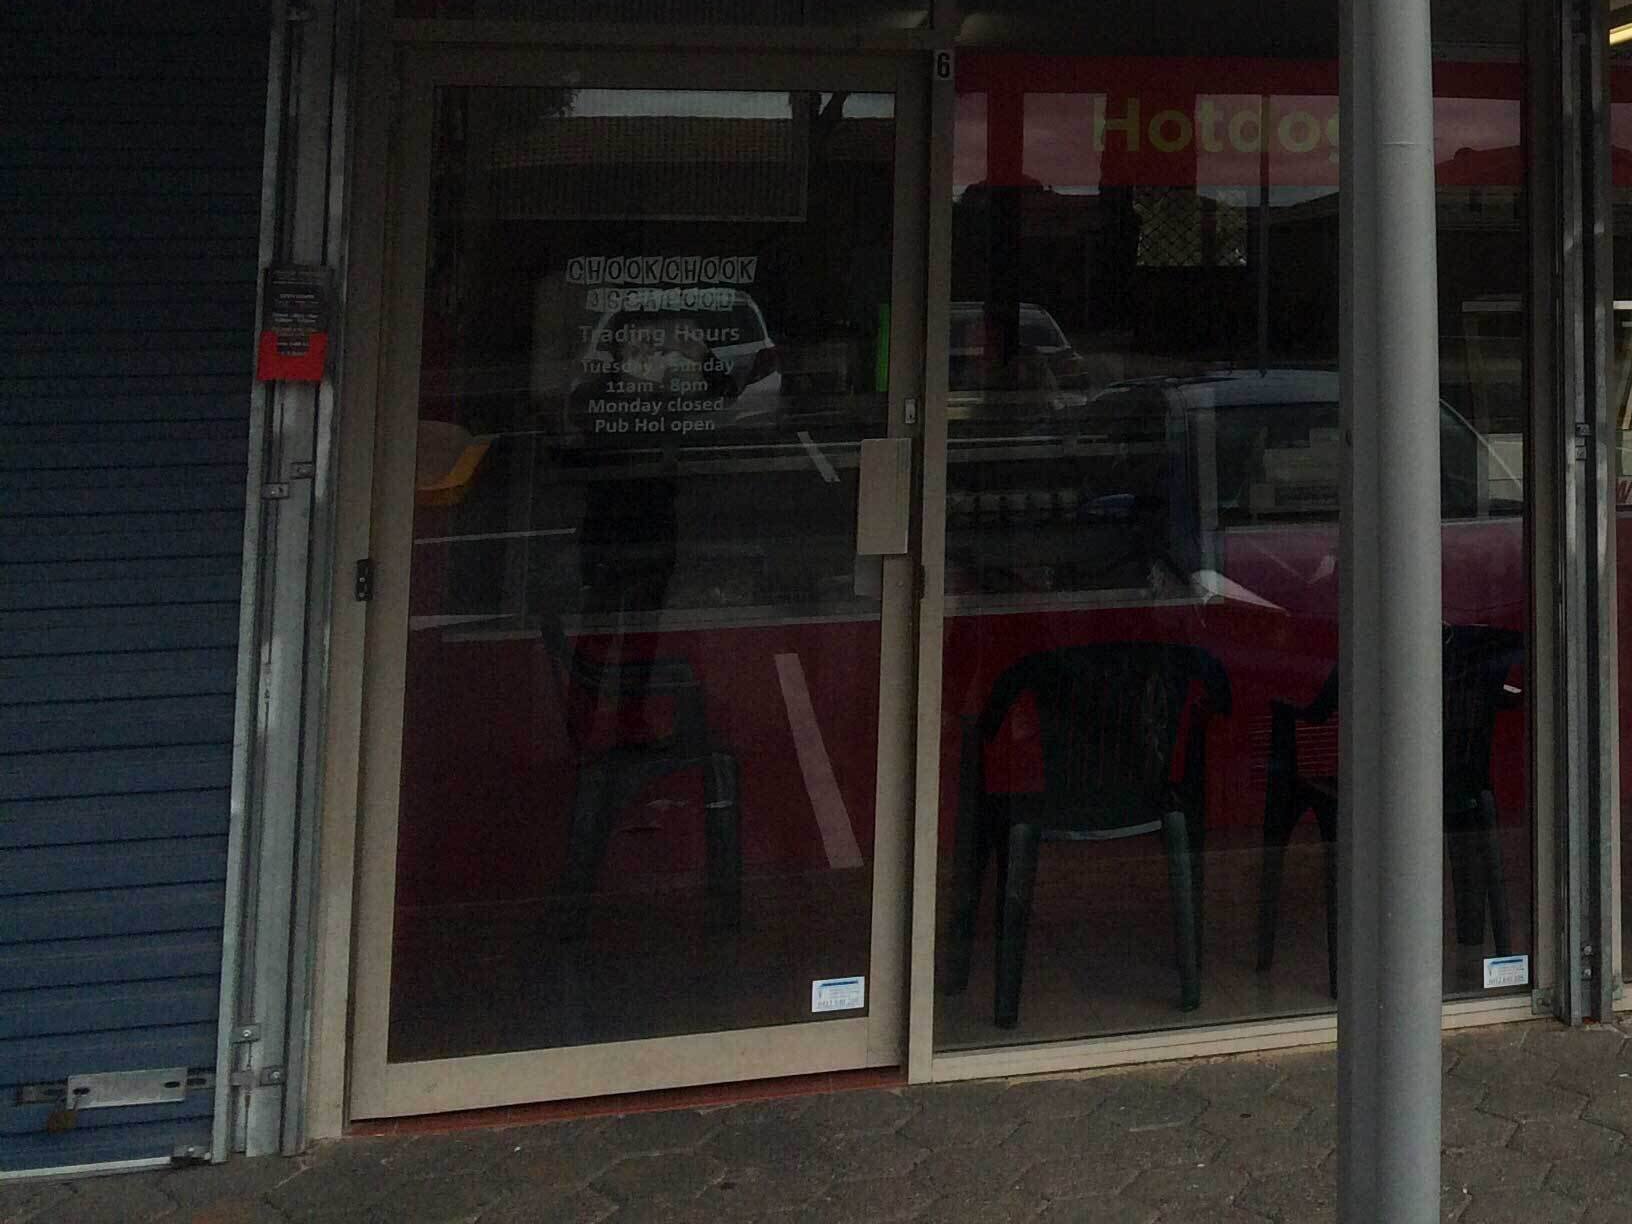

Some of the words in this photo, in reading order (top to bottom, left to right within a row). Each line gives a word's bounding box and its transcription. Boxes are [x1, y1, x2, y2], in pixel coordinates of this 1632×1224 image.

[935, 53, 951, 79] 6
[580, 324, 665, 345] Trading
[674, 323, 741, 342] Hours
[605, 380, 654, 393] 11am
[669, 378, 709, 395] 8pm
[588, 399, 663, 415] Monday
[667, 397, 724, 412] closed
[595, 419, 628, 433] Pub
[635, 417, 665, 432] Hol
[670, 419, 715, 435] open
